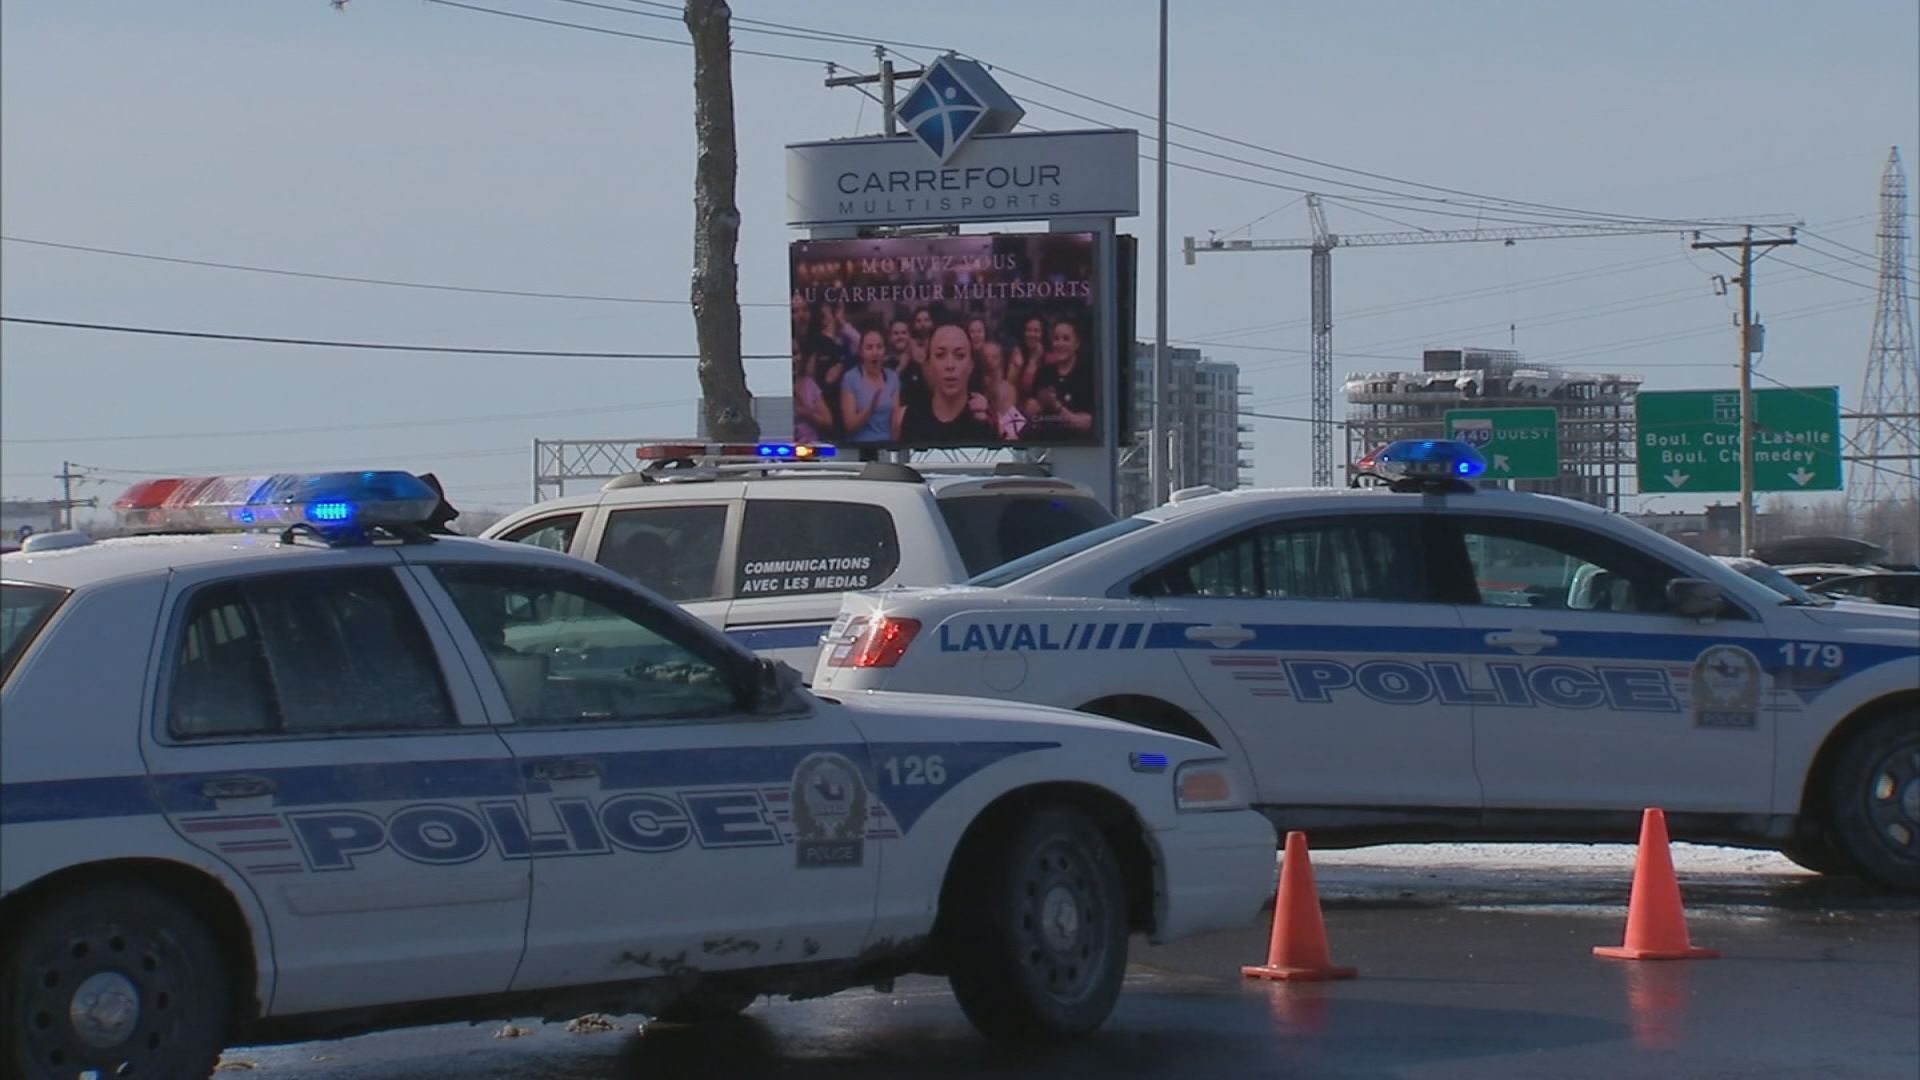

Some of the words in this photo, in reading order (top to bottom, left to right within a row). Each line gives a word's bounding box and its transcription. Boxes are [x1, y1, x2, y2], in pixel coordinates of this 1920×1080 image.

[838, 164, 1061, 194] CARREFOUR
[839, 193, 1061, 215] MULTISPORTS
[862, 254, 956, 274] MOTIVEZ
[961, 253, 1016, 271] VOUS
[793, 286, 817, 302] AU
[824, 283, 944, 302] CARREFOUR
[954, 279, 1091, 299] MULTISPORTS
[1497, 428, 1550, 440] OUEST
[1646, 432, 1690, 446] Boul.
[1662, 450, 1706, 463] Boul.
[1719, 449, 1815, 464] Chmedey
[744, 556, 871, 575] COMMUNICATIONS
[742, 577, 778, 592] AVEC
[784, 576, 810, 591] LES
[814, 574, 868, 590] MEDIAS
[940, 623, 1060, 652] LAVAL
[1779, 642, 1842, 668] 179
[1281, 659, 1682, 713] POLICE
[883, 755, 947, 787] 126
[285, 788, 783, 873] POLICE
